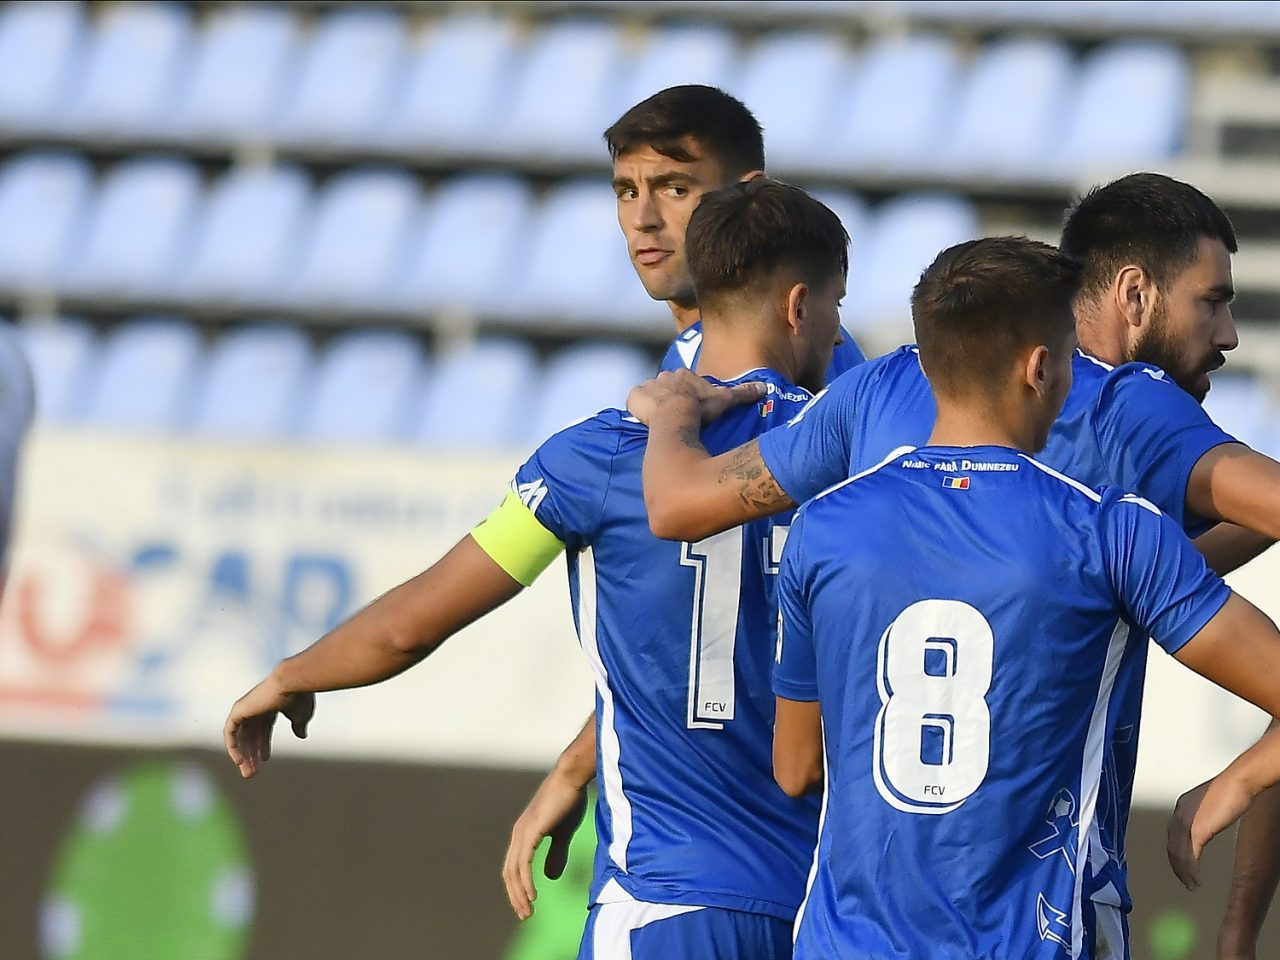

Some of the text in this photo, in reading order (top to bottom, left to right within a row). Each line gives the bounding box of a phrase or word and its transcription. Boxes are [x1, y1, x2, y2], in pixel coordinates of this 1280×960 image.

[704, 702, 727, 713] FCV
[872, 598, 995, 815] 8
[923, 785, 946, 796] FCV
